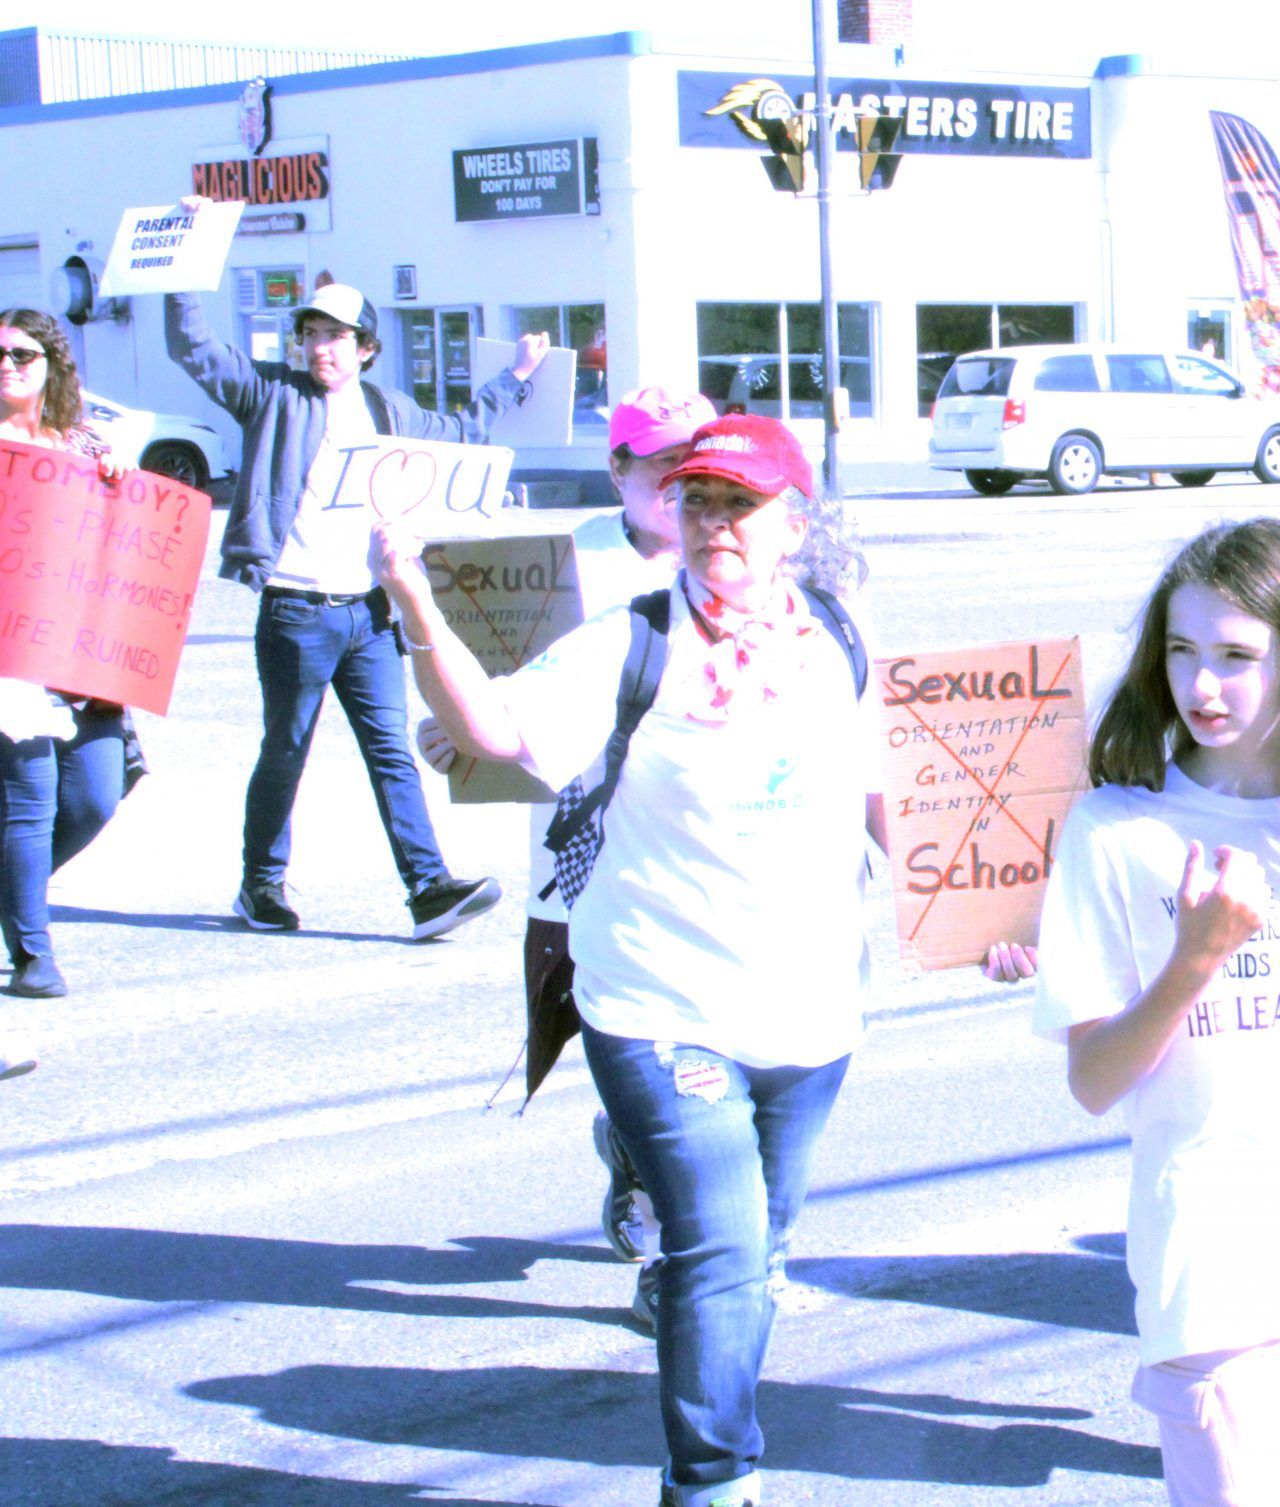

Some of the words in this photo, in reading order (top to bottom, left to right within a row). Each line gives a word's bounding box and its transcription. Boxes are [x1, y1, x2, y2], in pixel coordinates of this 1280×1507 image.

[803, 92, 977, 138] MASTERS
[991, 99, 1073, 140] TIRE
[463, 152, 524, 179] WHEELS
[526, 148, 572, 174] TIRES
[192, 152, 327, 206] MAGLICIOUS
[481, 179, 511, 193] DON'T
[514, 178, 533, 191] PAY
[535, 176, 557, 190] FOR
[496, 198, 514, 212] 100
[516, 196, 542, 210] DAYS
[134, 216, 195, 233] PARENTAL
[131, 234, 185, 251] CONSENT
[130, 255, 174, 269] REQUIRED
[321, 445, 379, 511] I
[77, 509, 183, 570] PHASE
[72, 628, 161, 680] RUINED
[958, 742, 995, 758] AND
[915, 761, 1026, 787] GENDER
[898, 793, 1012, 818] IDENTITY
[969, 816, 991, 832] IN
[906, 817, 1055, 896] School
[1223, 952, 1271, 979] KIDS
